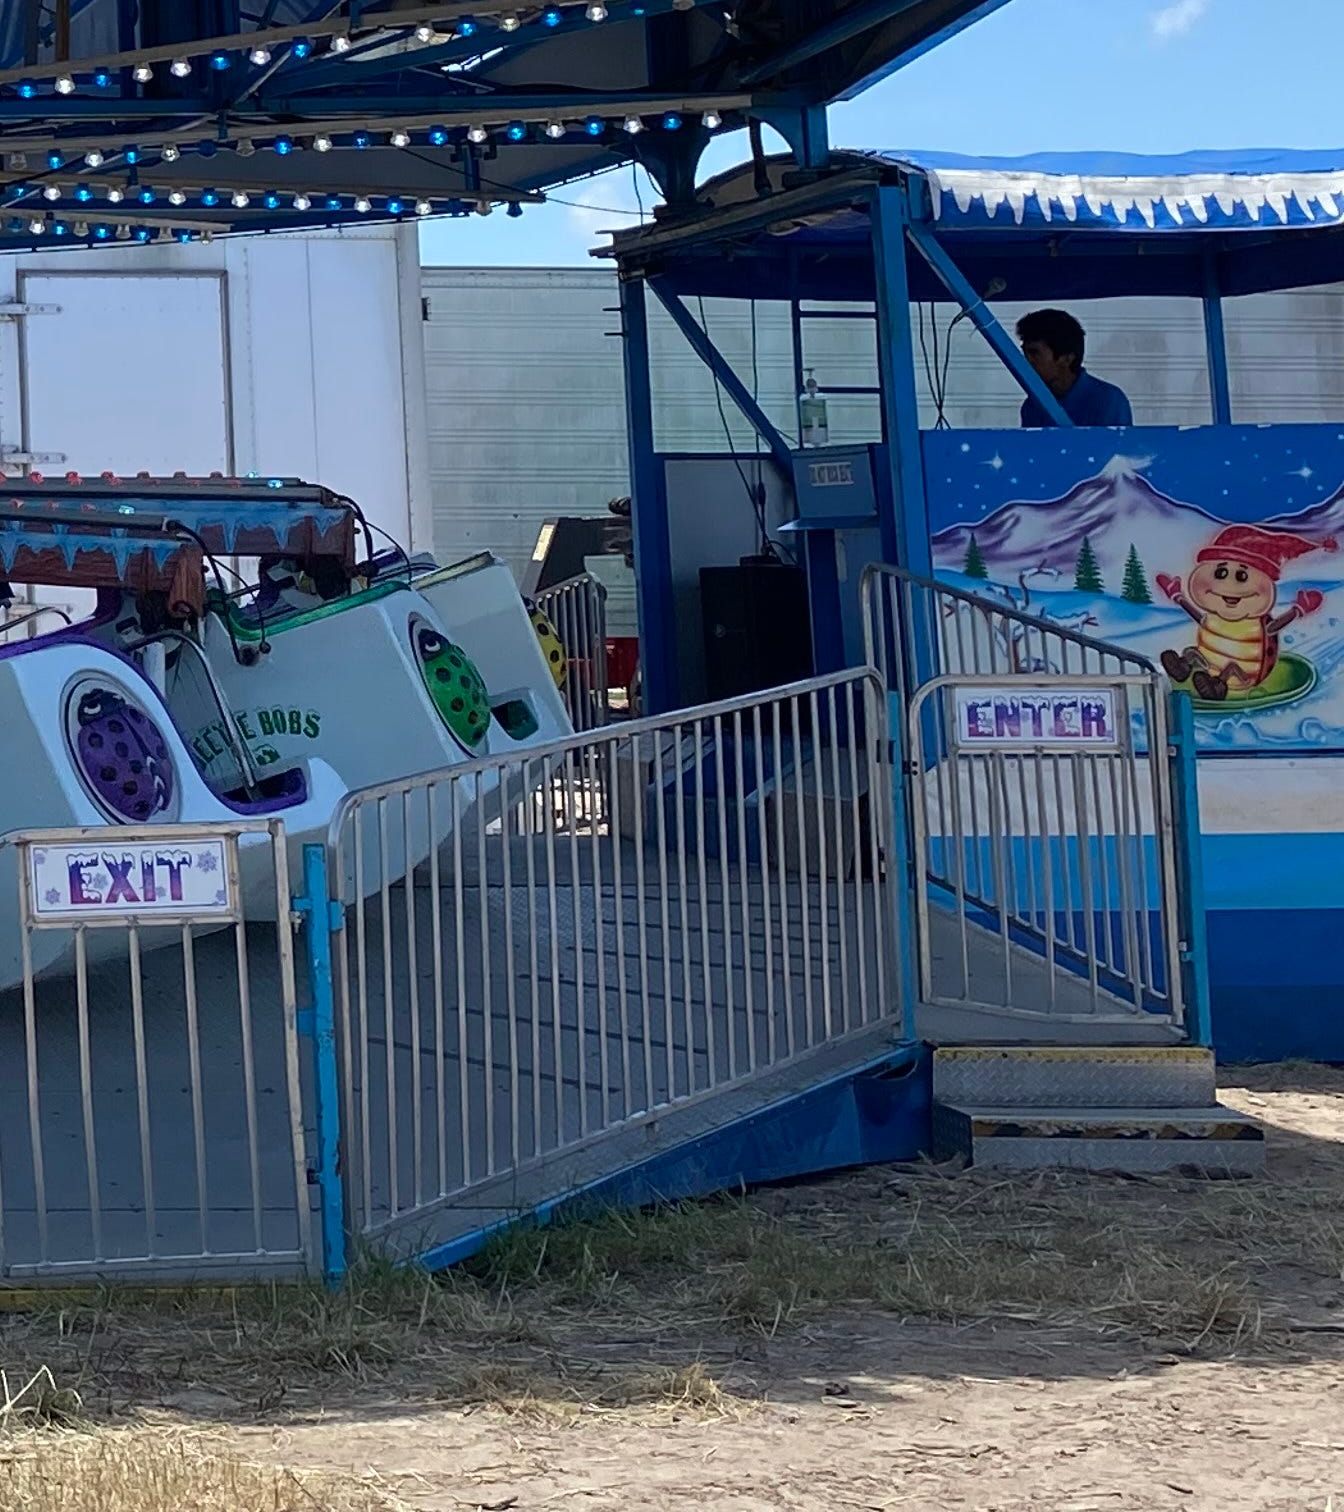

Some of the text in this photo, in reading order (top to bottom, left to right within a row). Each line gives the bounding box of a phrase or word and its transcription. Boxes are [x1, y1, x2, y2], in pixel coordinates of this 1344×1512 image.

[257, 708, 321, 739] BOBS
[965, 695, 1106, 737] ENTER
[66, 849, 192, 904] EXIT
